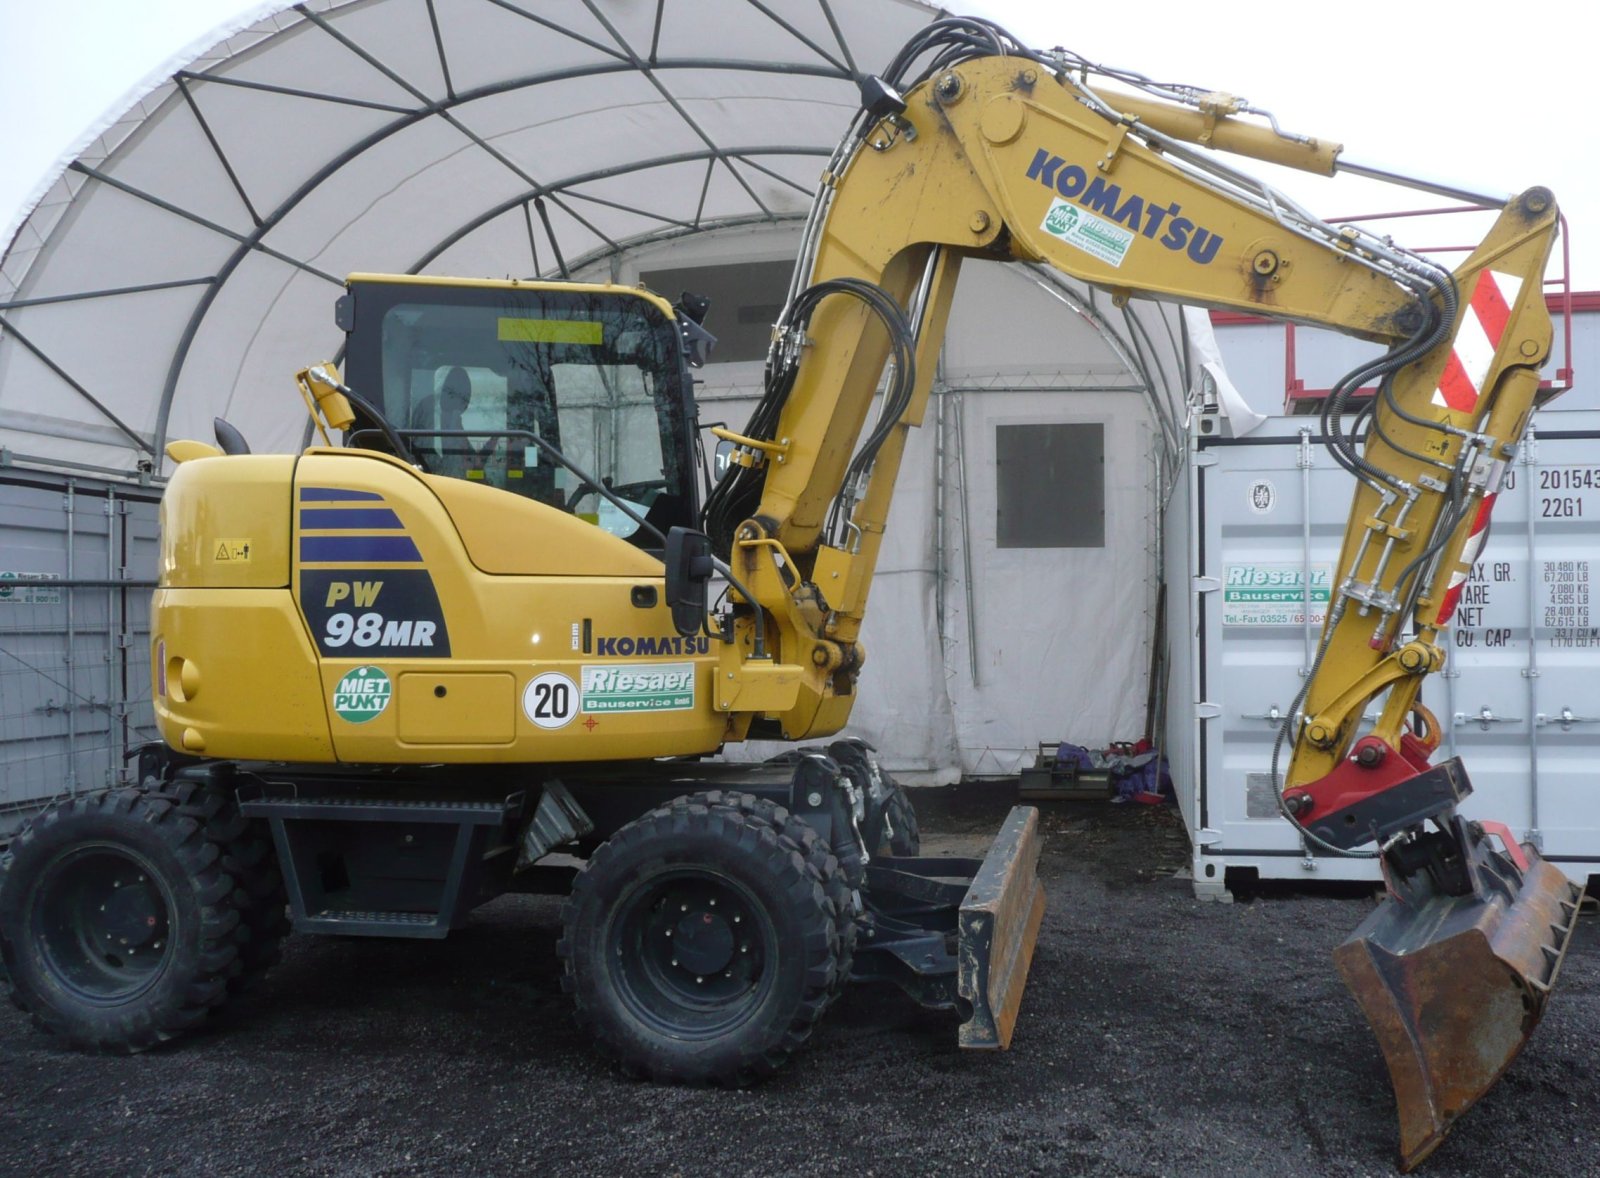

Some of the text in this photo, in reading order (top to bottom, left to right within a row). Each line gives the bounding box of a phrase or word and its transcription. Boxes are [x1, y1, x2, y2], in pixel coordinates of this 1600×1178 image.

[1025, 148, 1224, 265] KOMATSU
[1051, 206, 1078, 226] MIET
[1046, 214, 1074, 233] PUNKT
[1540, 470, 1600, 489] 201543
[1542, 497, 1582, 517] 22G1
[1468, 563, 1490, 582] AX.
[1494, 563, 1516, 582] GR.
[1577, 562, 1588, 571] KG
[1577, 572, 1589, 582] LB
[325, 581, 384, 607] PW
[1230, 591, 1325, 600] Bauservie
[1577, 584, 1589, 594] KG
[1577, 594, 1589, 604] LB
[1225, 615, 1258, 623] Tel.-Fax
[1260, 615, 1288, 623] 03525
[1457, 608, 1483, 627] NET
[1577, 607, 1589, 616] KG
[1577, 617, 1589, 627] LB
[323, 612, 437, 648] 98MR
[1456, 629, 1477, 648] CU.
[1485, 628, 1516, 647] CAP.
[597, 636, 709, 656] KOMATSU
[340, 678, 389, 693] MIET
[588, 668, 693, 693] Riesaer
[335, 694, 390, 710] PUNKT
[534, 683, 569, 718] 20
[586, 699, 671, 708] Bauservice
